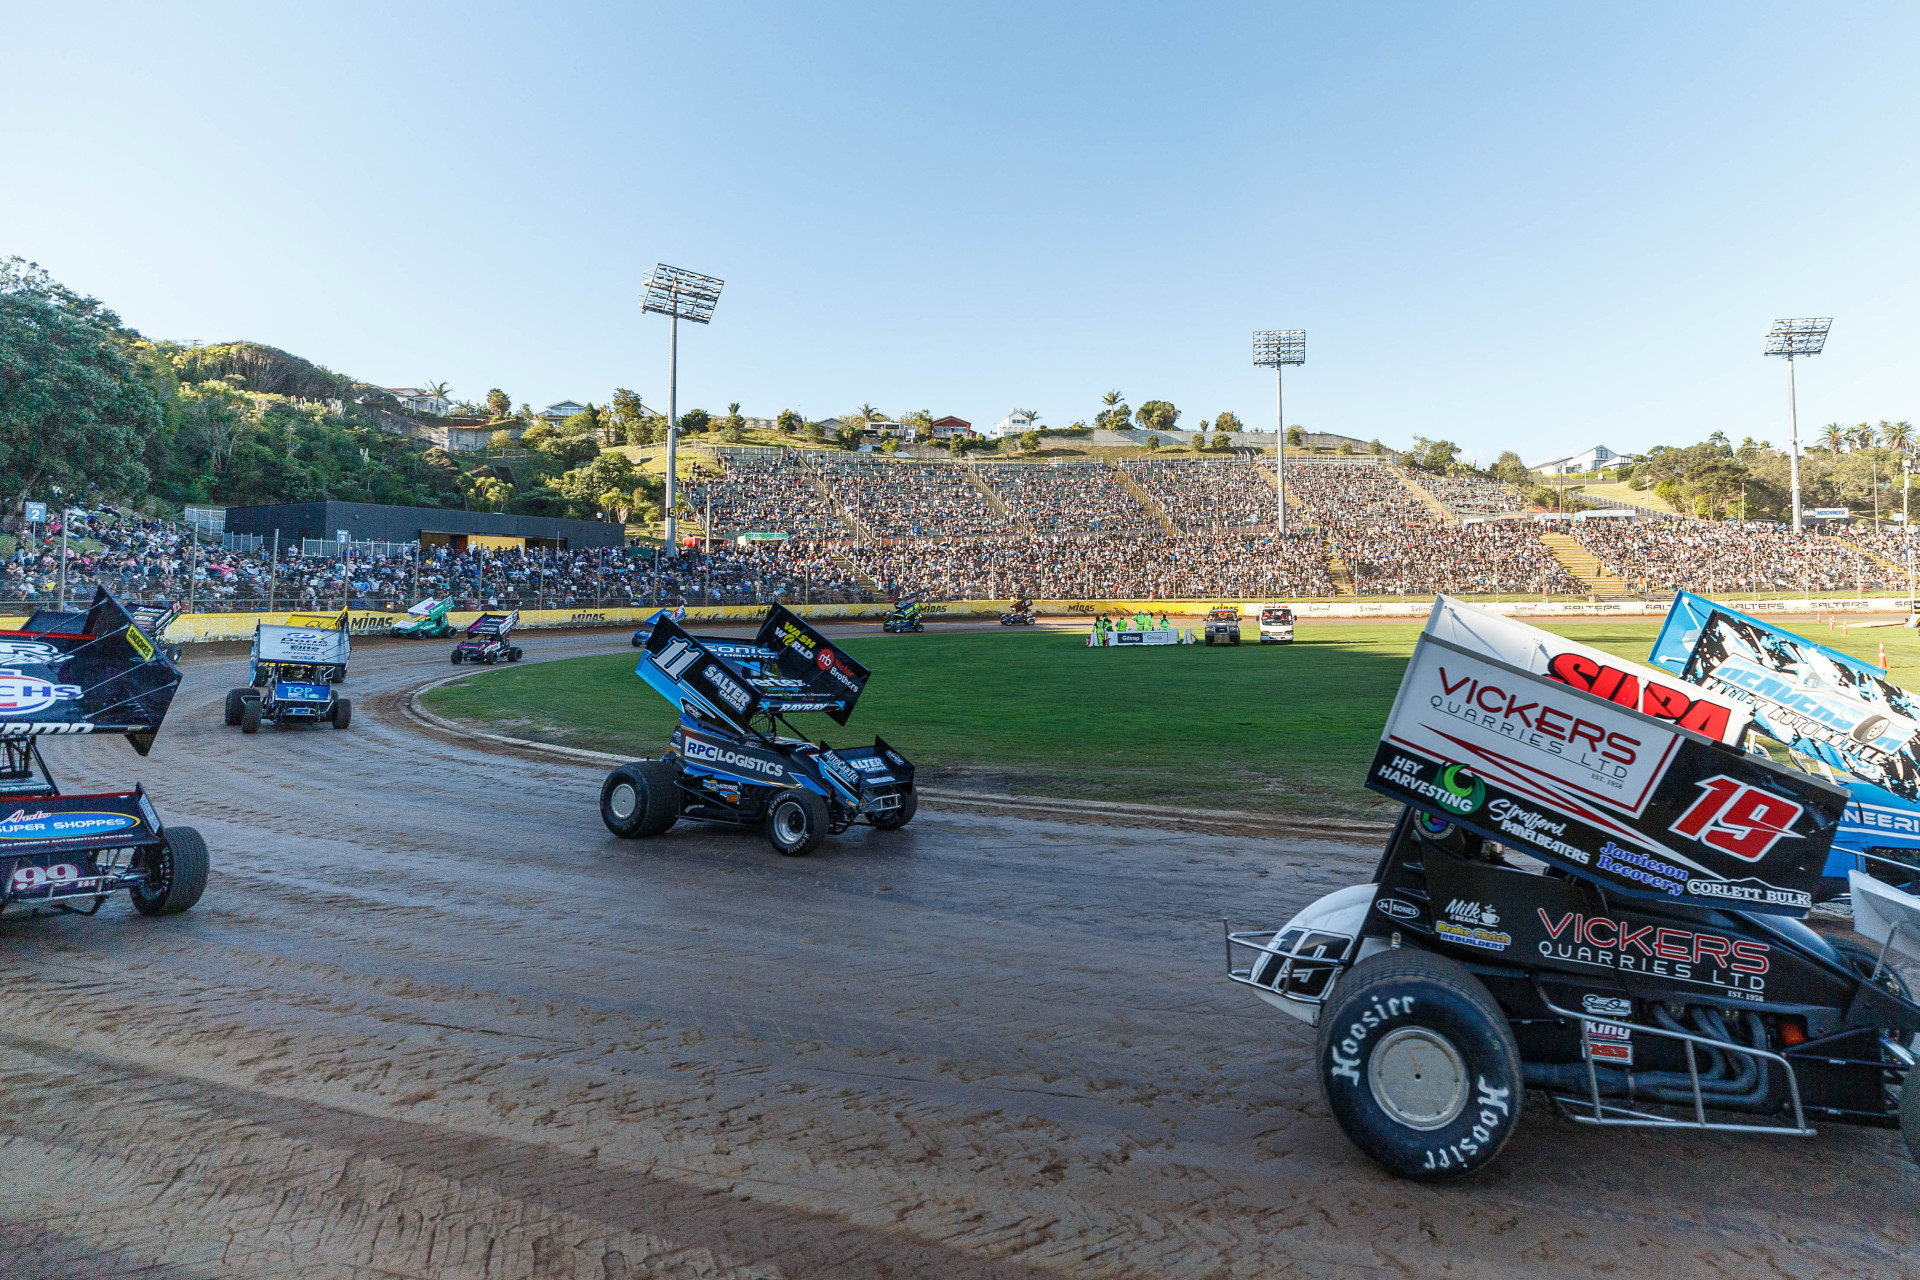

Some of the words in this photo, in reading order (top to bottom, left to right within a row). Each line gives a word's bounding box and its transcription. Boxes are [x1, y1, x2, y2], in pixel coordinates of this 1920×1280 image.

[31, 509, 40, 520] 2
[340, 535, 346, 543] 3
[571, 610, 606, 621] MIDAS
[920, 603, 947, 613] MIDAS
[1067, 602, 1095, 612] MIDAS
[1727, 602, 1785, 610] SALTERS
[1810, 601, 1869, 609] SALTERS
[350, 613, 394, 629] MIDAS
[774, 627, 814, 660] WORLD
[784, 621, 816, 649] WASH
[649, 637, 703, 683] 11
[834, 658, 855, 678] Motor
[286, 686, 313, 694] TOP
[704, 665, 751, 706] SALTER
[830, 666, 859, 693] Brothers
[719, 689, 745, 712] CARTAGE
[780, 702, 828, 712] RAYRAY
[1439, 666, 1641, 766] VICKERS
[1430, 695, 1565, 755] QUARRIES
[1581, 752, 1628, 779] LTD
[687, 741, 716, 759] RPC
[717, 749, 784, 777] LOGISTICS
[850, 757, 884, 769] ALTER
[1391, 755, 1424, 775] HEY
[1378, 765, 1473, 812] HARVESTING
[1591, 773, 1605, 784] EST.
[1606, 778, 1623, 790] 1958
[0, 809, 52, 824] Auto
[0, 823, 46, 833] SUPER
[53, 818, 126, 830] SHOPPES
[1488, 798, 1567, 837] Stratford
[1668, 774, 1807, 863] 19
[1841, 809, 1920, 833] NEERI
[1500, 819, 1590, 865] PANELBEATERS
[1600, 841, 1689, 882] Jamieson
[14, 863, 79, 890] 99
[1597, 855, 1685, 896] Recovery
[1689, 879, 1762, 900] CORLETT
[1766, 890, 1811, 907] BULK
[1380, 901, 1389, 909] 24
[1393, 903, 1417, 916] BONES
[1445, 898, 1481, 919] Milk
[1456, 915, 1479, 925] BEANS
[1437, 921, 1472, 937] Brake
[1474, 930, 1510, 944] Clutch
[1441, 933, 1504, 951] REBUILDERS
[1537, 907, 1770, 974] VICKERS
[1538, 941, 1692, 979] QUARRIES
[1712, 969, 1765, 991] LTD
[1728, 990, 1743, 999] EST.
[1745, 993, 1764, 1003] 1958
[1331, 995, 1415, 1087] Hoosier
[1424, 1075, 1510, 1169] Hoosier
